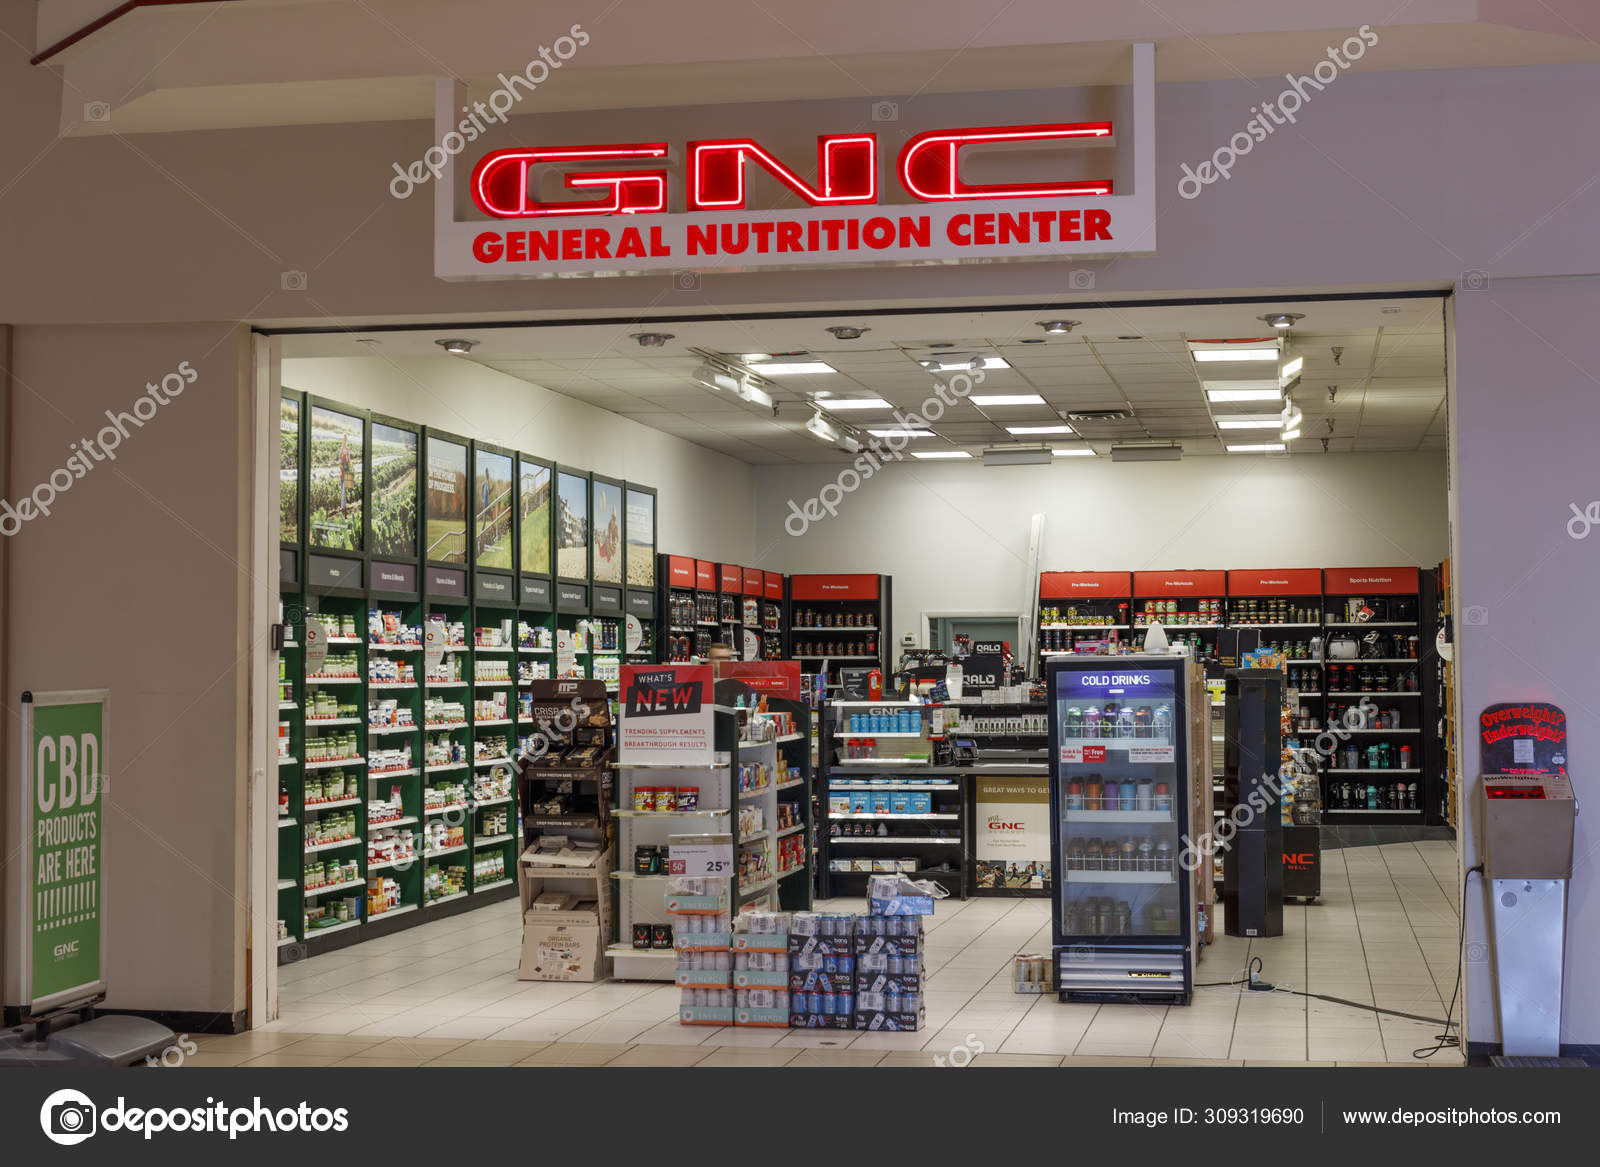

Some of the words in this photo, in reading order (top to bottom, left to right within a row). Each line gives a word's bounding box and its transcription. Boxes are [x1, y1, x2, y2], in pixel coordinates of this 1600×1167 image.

[470, 121, 1114, 219] GNC
[472, 226, 671, 264] GENERAL
[686, 216, 931, 256] NUTRITION
[946, 209, 1113, 247] CENTER
[976, 645, 1001, 653] QALO
[638, 674, 673, 683] WHAT'S
[963, 674, 996, 685] QALO
[1081, 675, 1109, 686] COLD
[1111, 675, 1150, 685] DRINKS
[635, 687, 694, 712] NEW
[1481, 704, 1566, 727] Overweight?
[1482, 721, 1566, 744] Underweight?
[37, 733, 98, 813] CBD
[38, 812, 97, 848] PRODUCTS
[988, 822, 1025, 830] GNC
[37, 850, 62, 885] ARE
[65, 844, 97, 879] HERE
[1282, 853, 1314, 864] NC
[54, 940, 80, 956] GNC
